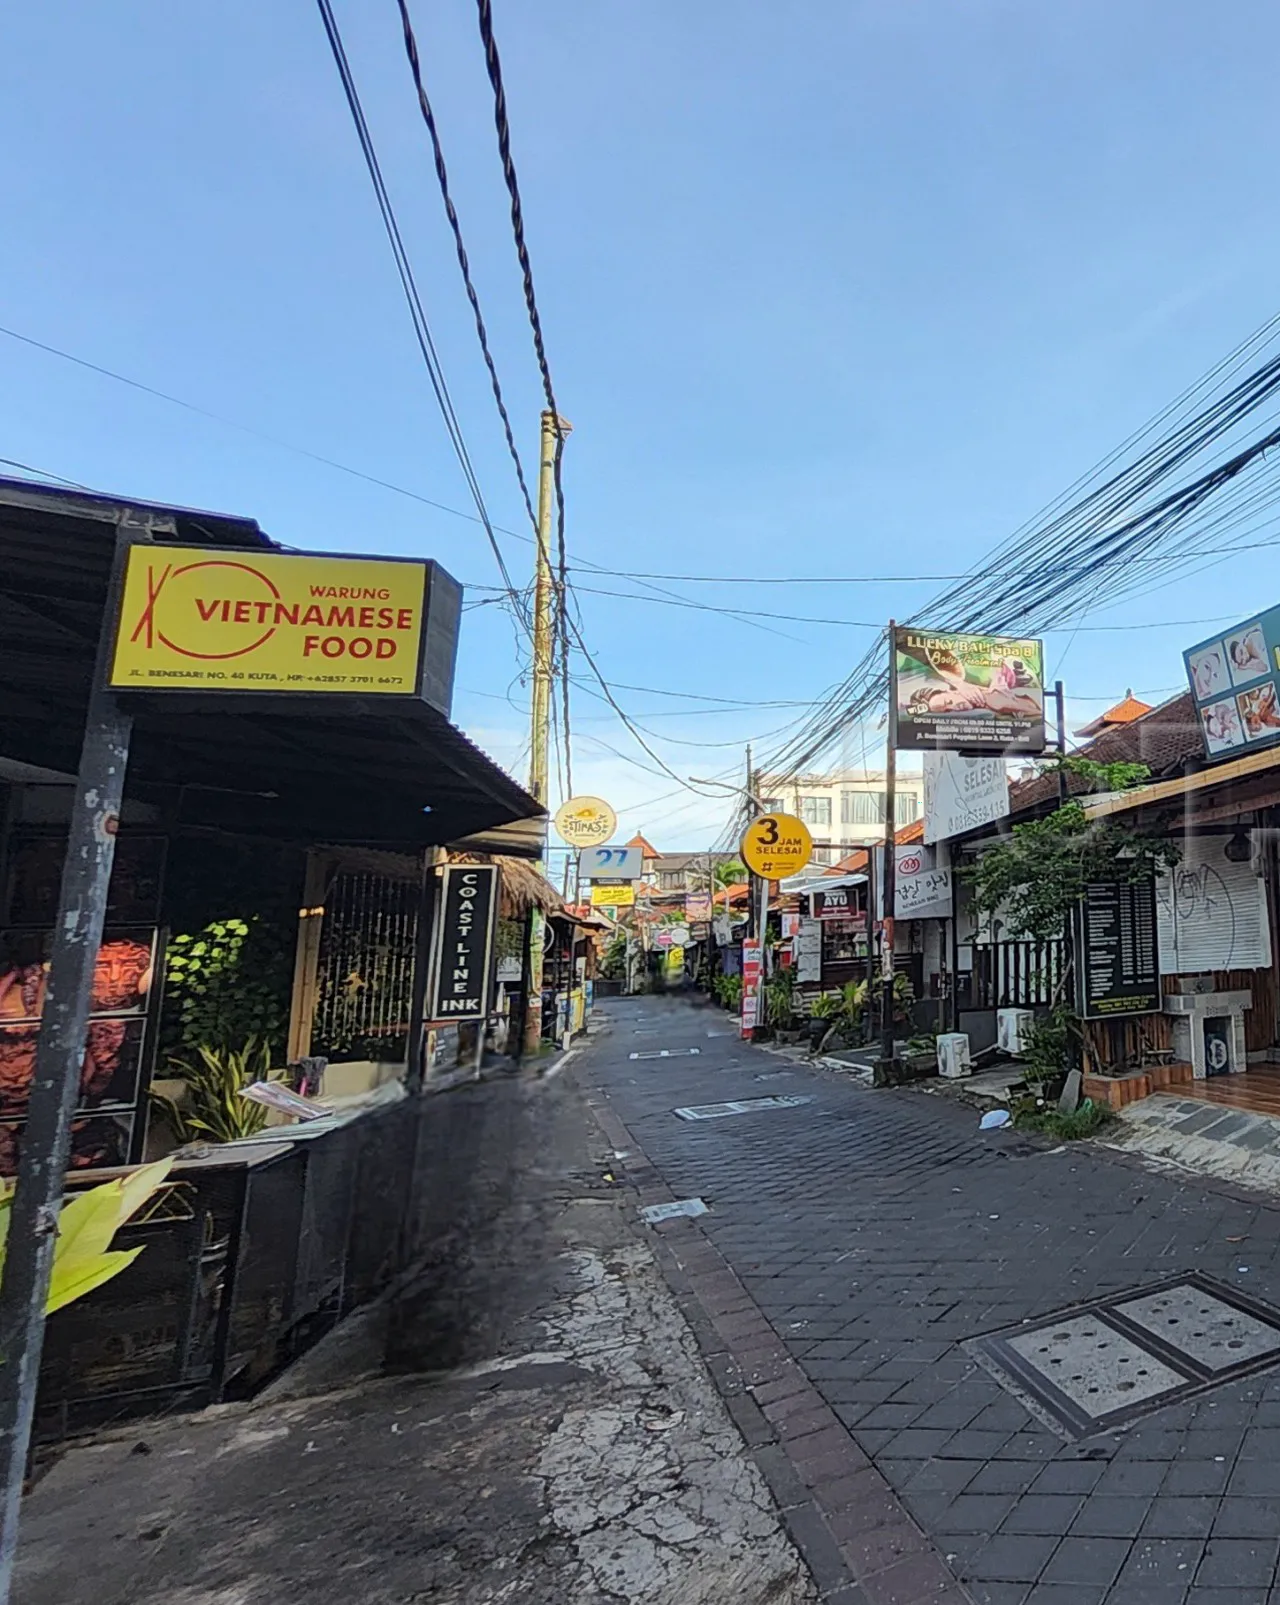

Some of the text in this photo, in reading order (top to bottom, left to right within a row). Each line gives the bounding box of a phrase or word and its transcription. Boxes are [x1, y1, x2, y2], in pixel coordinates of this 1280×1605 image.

[309, 585, 391, 600] WARUNG
[195, 598, 413, 630] VIETNAMESE
[302, 635, 397, 660] FOOD
[907, 635, 1034, 658] LUCKY BALI Spa 8
[931, 651, 957, 665] Body
[148, 669, 204, 678] BENESARI
[207, 671, 228, 679] NO.
[248, 672, 278, 681] KUTA
[913, 716, 932, 724] OPEN
[756, 818, 802, 846] 3 JAM
[755, 846, 802, 855] SELESAI
[595, 849, 629, 868] 27
[823, 896, 848, 907] AYU
[441, 998, 480, 1012] INK
